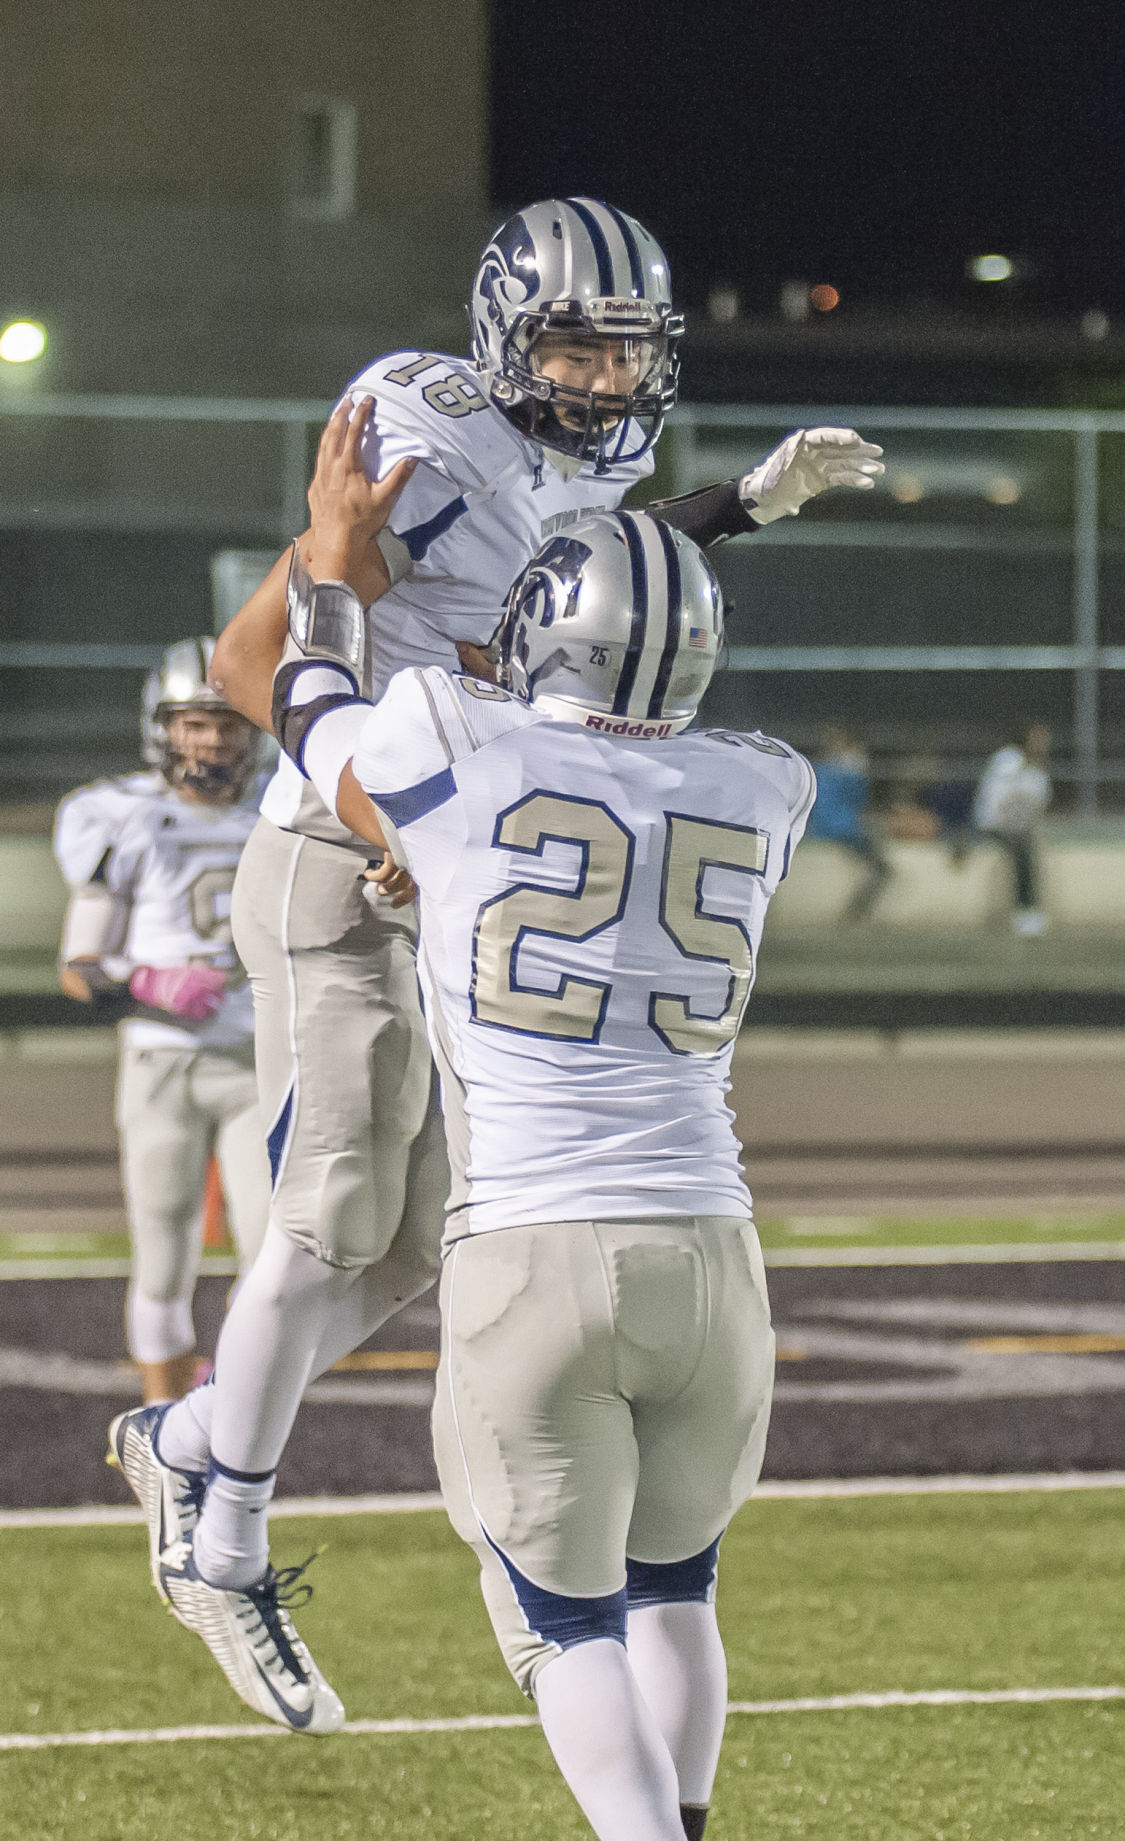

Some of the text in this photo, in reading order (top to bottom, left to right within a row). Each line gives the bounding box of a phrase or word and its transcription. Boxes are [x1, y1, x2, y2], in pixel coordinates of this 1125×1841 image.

[604, 301, 641, 314] Riddell
[382, 354, 491, 419] 18
[589, 645, 609, 667] 25
[585, 715, 673, 738] Riddell
[468, 787, 770, 1061] 25
